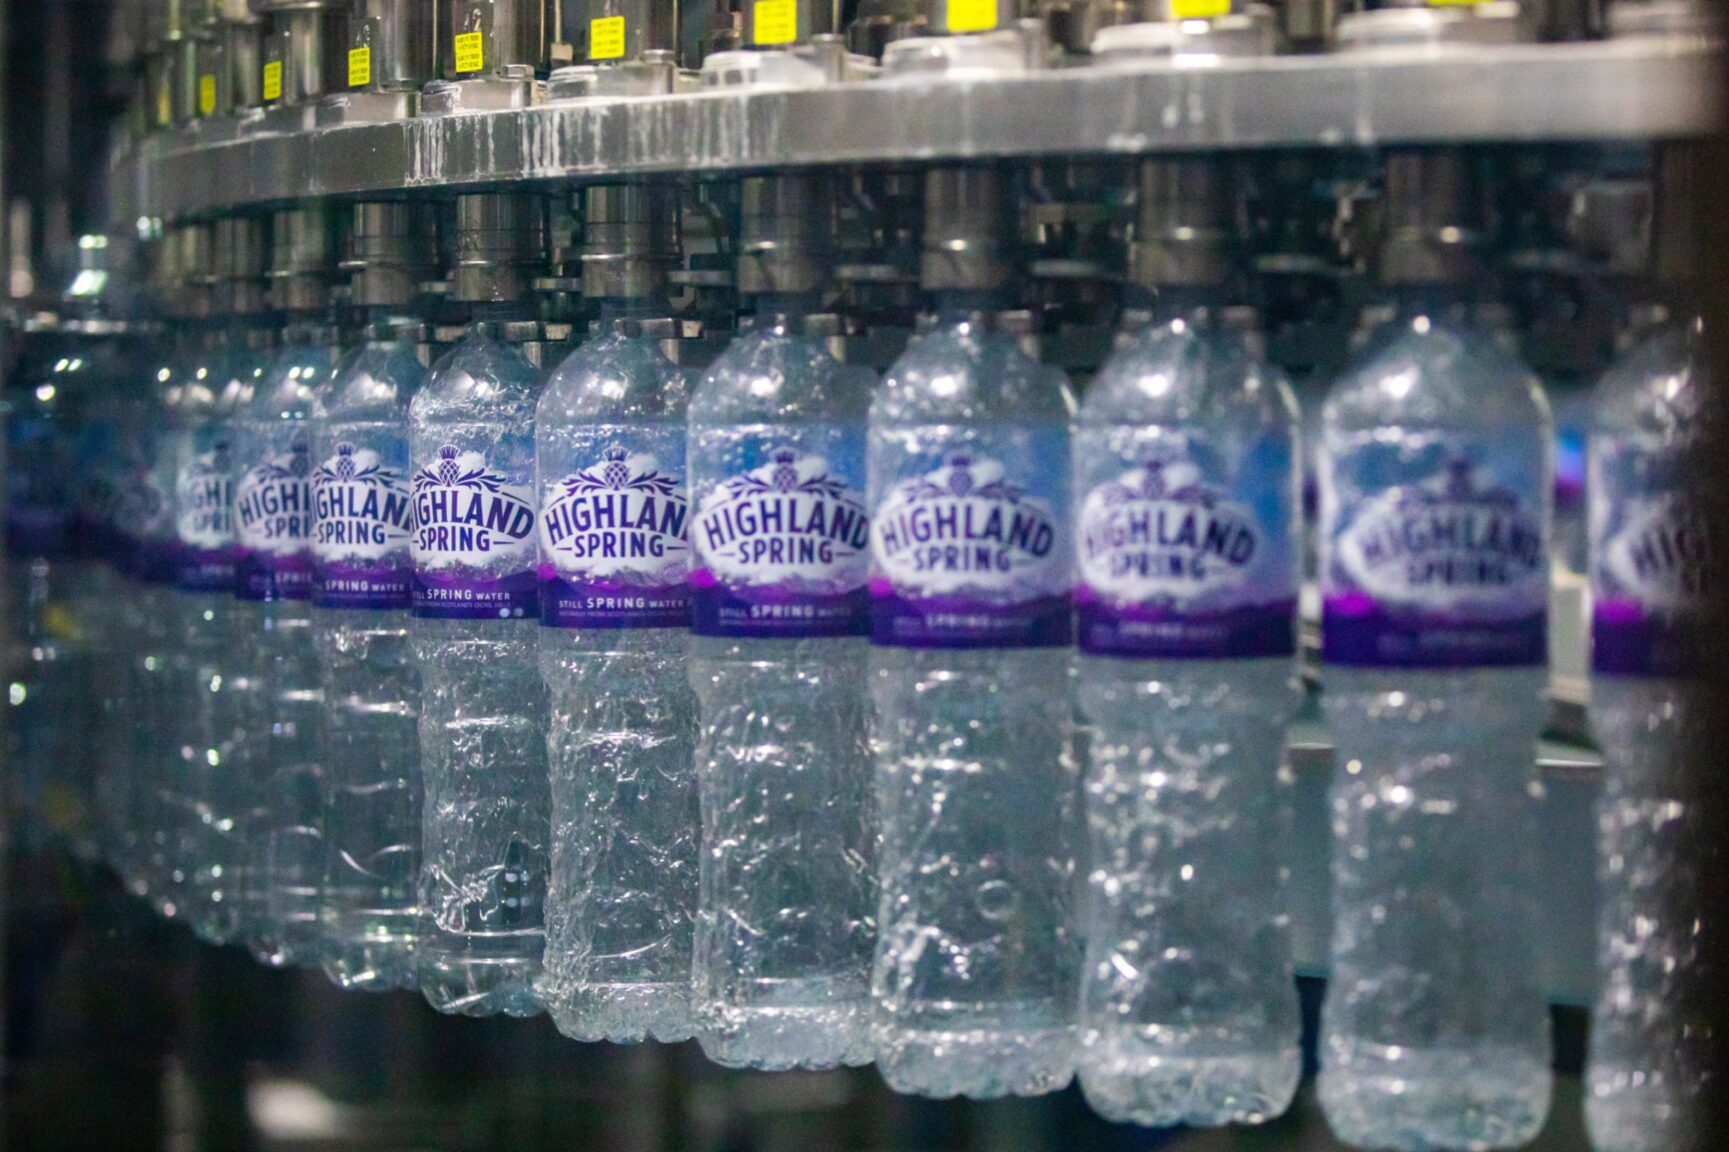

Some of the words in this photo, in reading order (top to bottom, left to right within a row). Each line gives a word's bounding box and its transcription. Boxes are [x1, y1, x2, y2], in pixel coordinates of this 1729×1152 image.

[264, 515, 310, 539] SPRI
[318, 520, 385, 544] SPRING
[545, 494, 687, 546] HIGHLAN
[703, 498, 868, 550] HIGHLAND
[879, 504, 1053, 558] HIGHLAND
[420, 525, 490, 552] SPRING
[574, 531, 664, 558] SPRING
[739, 537, 833, 564] SPRING
[913, 545, 1011, 573] SPRING
[325, 580, 368, 592] SPRING
[371, 583, 405, 592] WATER
[427, 588, 472, 601] SPRING
[475, 592, 511, 601] WATER
[559, 599, 583, 609] STILL
[586, 597, 645, 609] SPRING
[648, 599, 684, 608] WATER
[751, 604, 814, 618] SPRING
